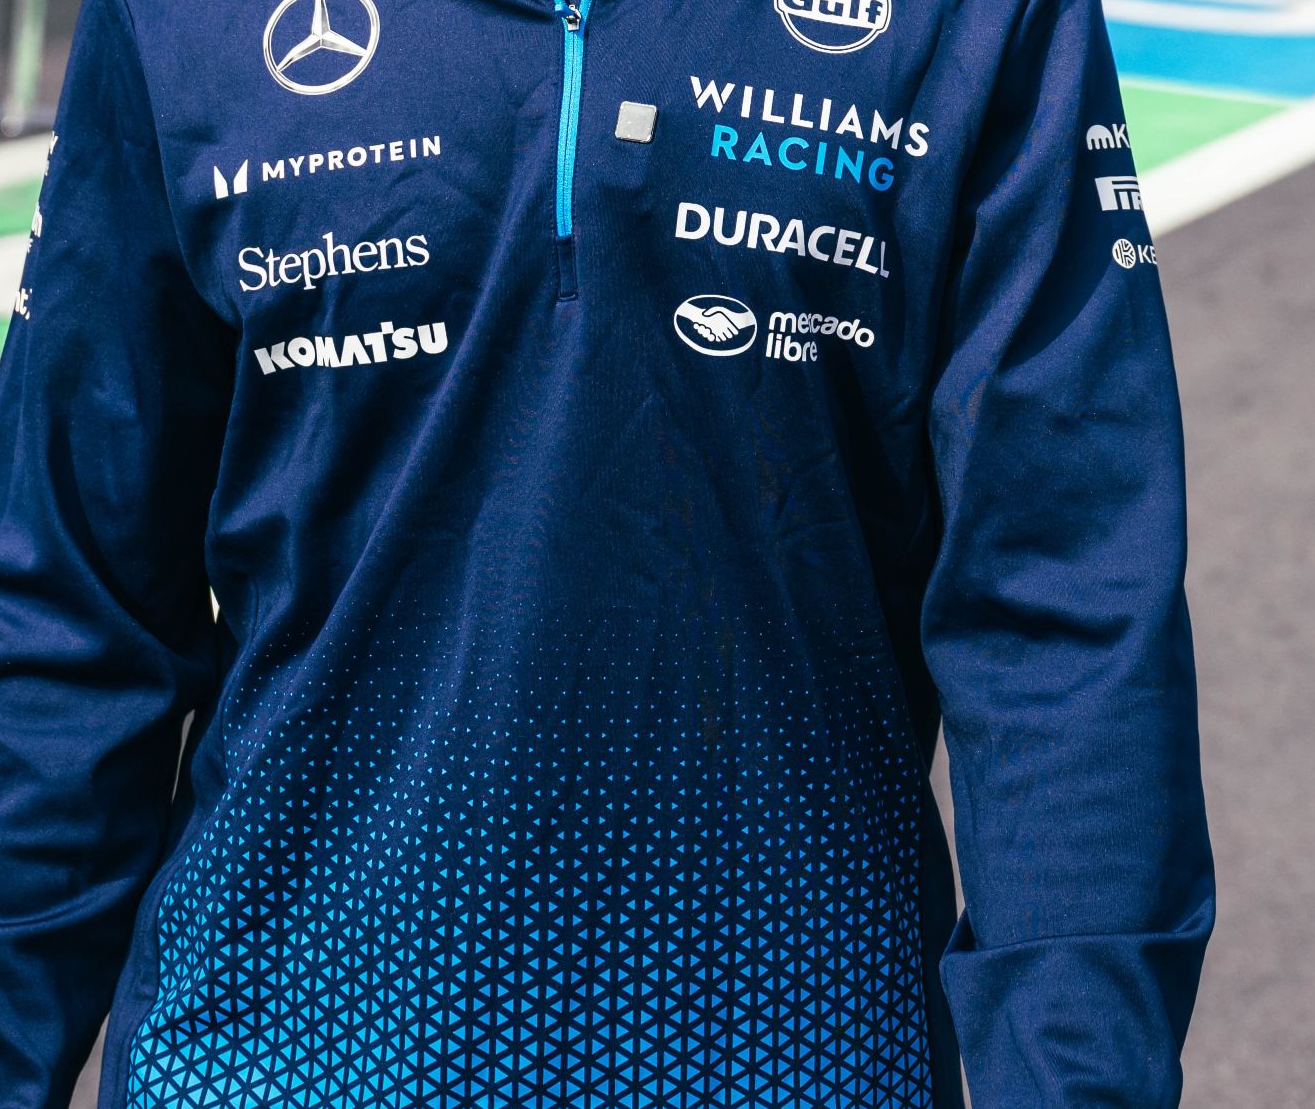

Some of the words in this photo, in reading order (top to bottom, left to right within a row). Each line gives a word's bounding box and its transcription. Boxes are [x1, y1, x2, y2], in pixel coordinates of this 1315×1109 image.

[690, 75, 931, 158] WILLIAMS
[262, 135, 441, 182] MYPROTEIN
[710, 123, 895, 192] RACING
[238, 231, 431, 292] Stephens
[675, 201, 891, 279] DURACELL
[254, 321, 449, 376] KOMATSU
[765, 332, 819, 362] libre
[768, 311, 875, 348] mercado
